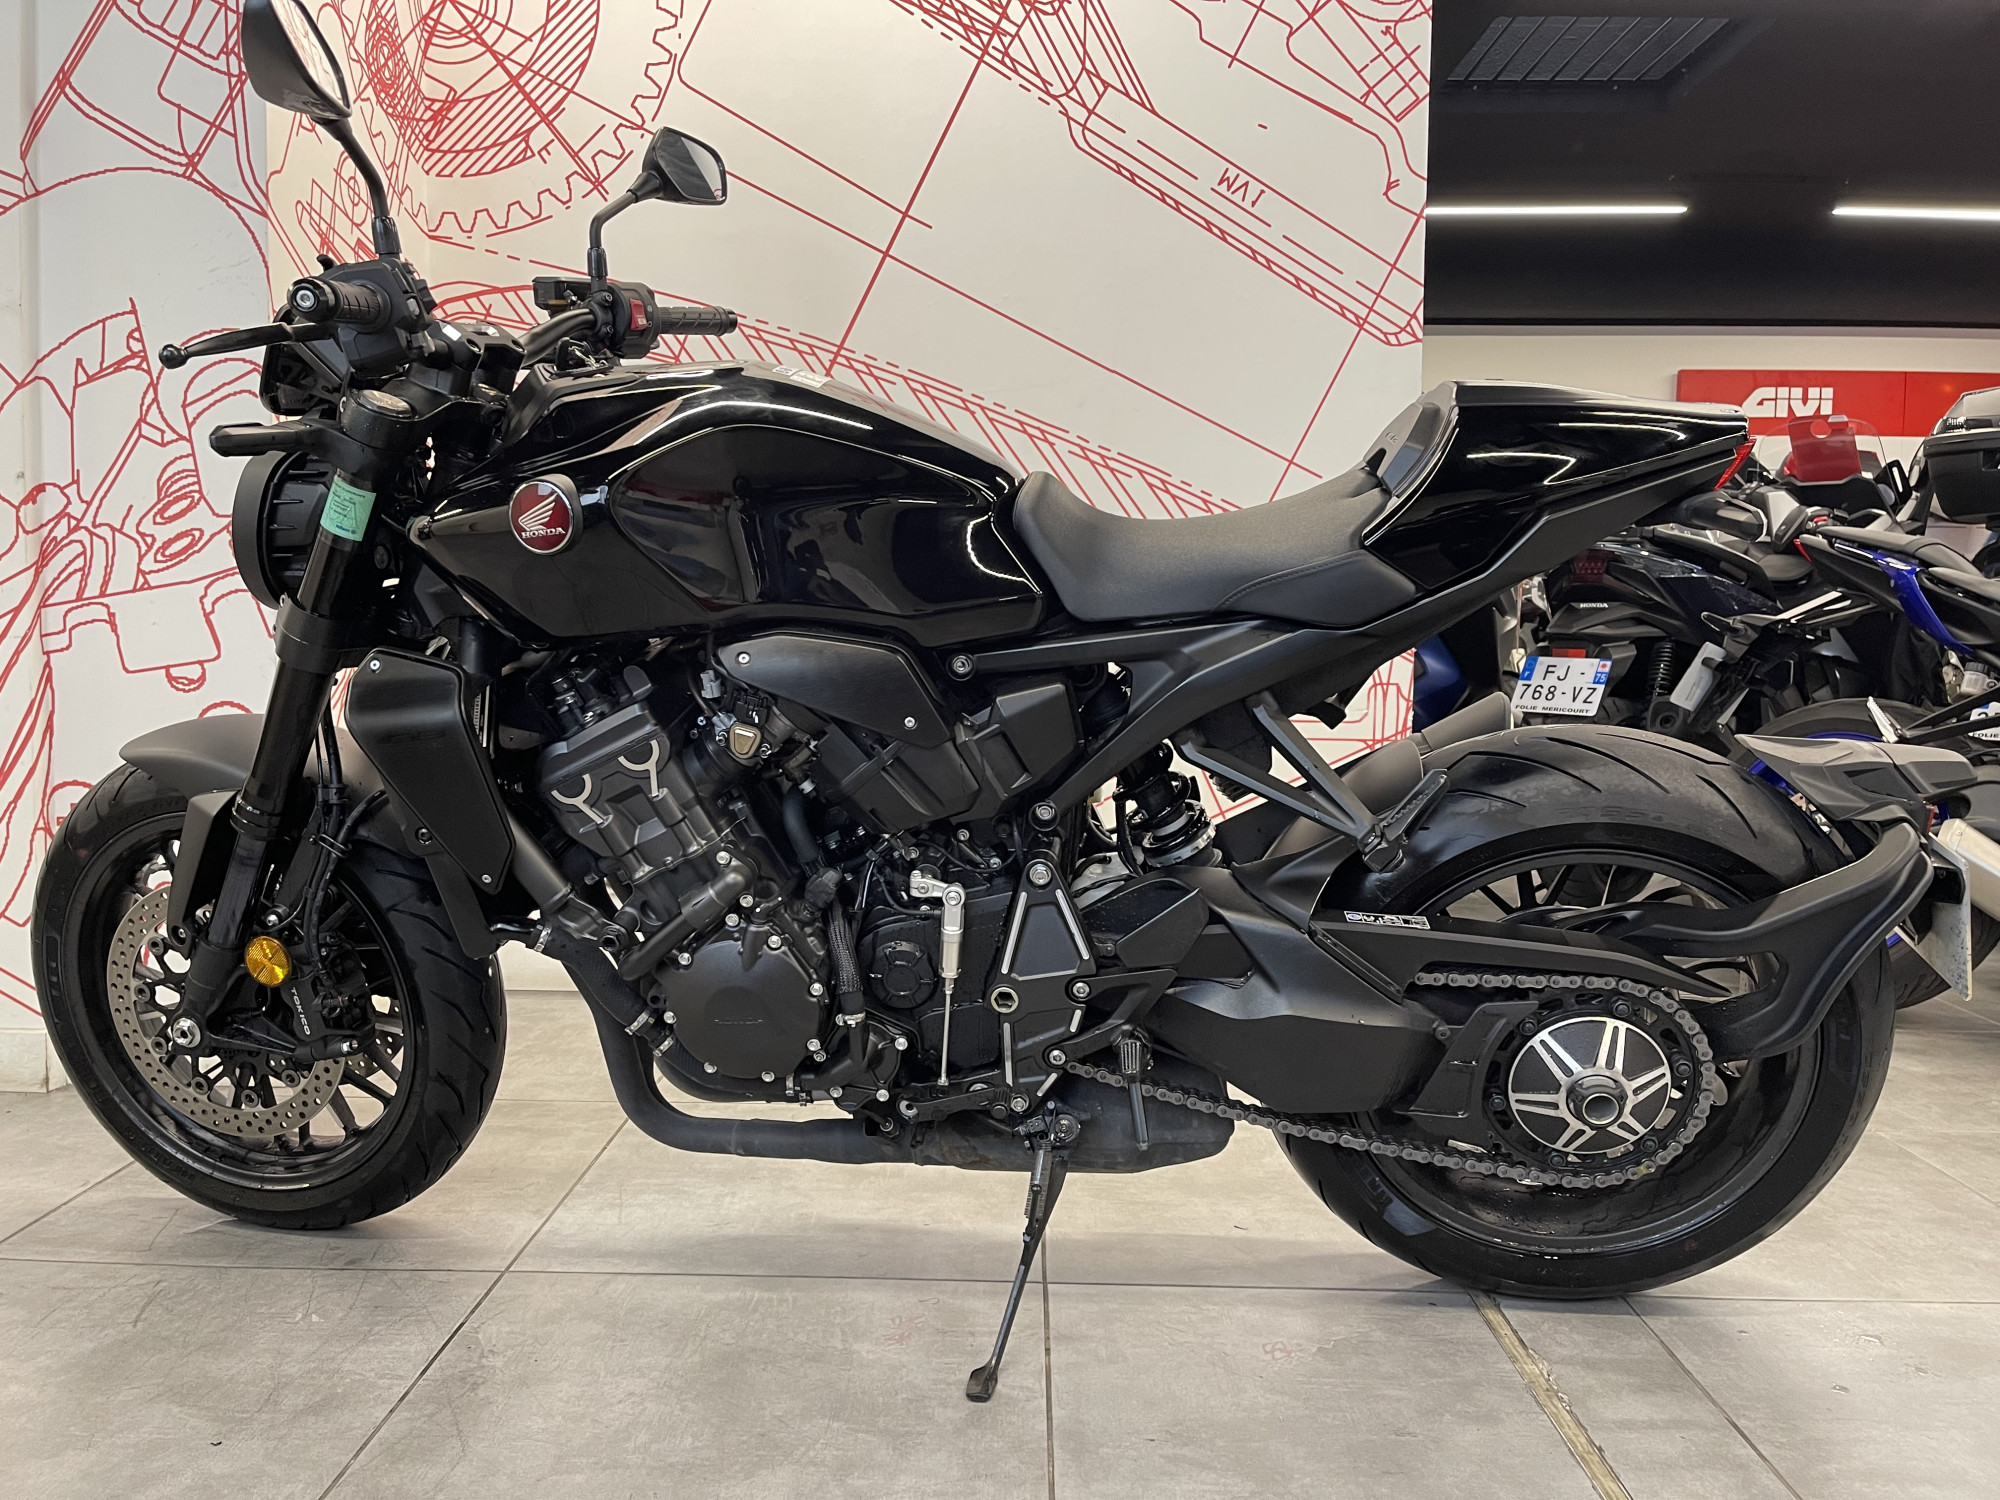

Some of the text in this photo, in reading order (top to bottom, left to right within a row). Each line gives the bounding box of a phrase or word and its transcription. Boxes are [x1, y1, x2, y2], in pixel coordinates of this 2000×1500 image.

[1742, 386, 1834, 418] GIVI
[521, 527, 566, 539] HONDA
[1594, 673, 1607, 683] 75
[1541, 706, 1591, 714] MERICOURT
[290, 986, 311, 1036] TOKICO
